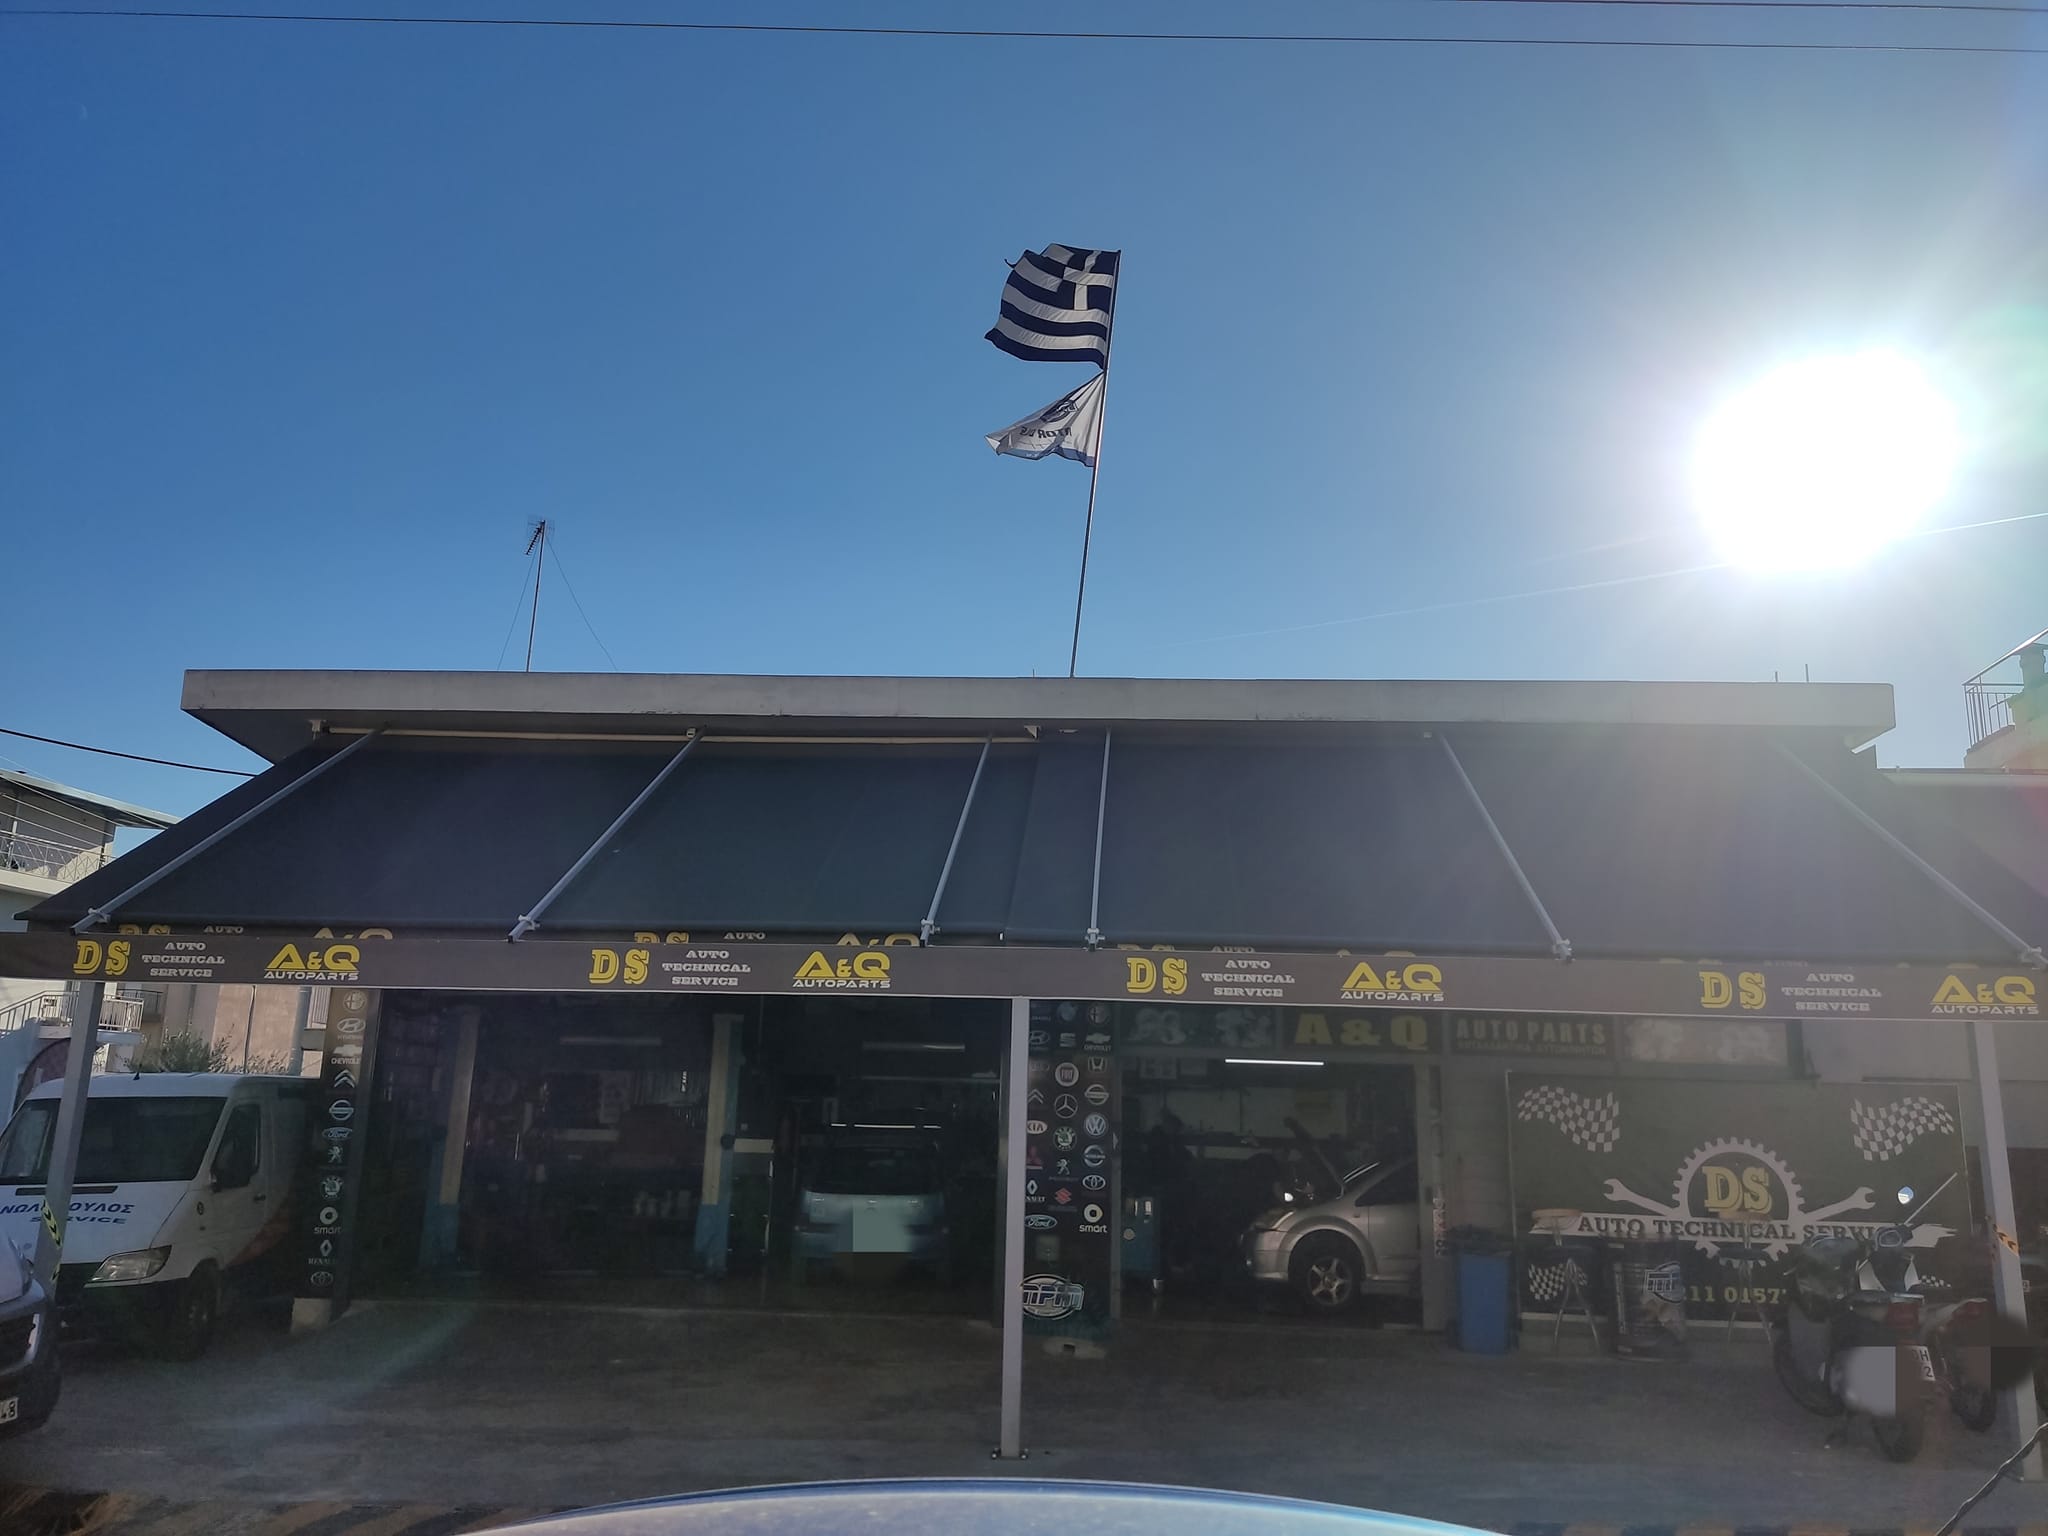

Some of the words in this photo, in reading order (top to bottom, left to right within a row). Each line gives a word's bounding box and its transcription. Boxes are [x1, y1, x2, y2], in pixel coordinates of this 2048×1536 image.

[204, 925, 243, 934] AUTO
[724, 932, 766, 940] AUTO
[165, 942, 206, 951] AUTO
[73, 940, 130, 976] DS
[141, 955, 225, 964] TECHNICAL
[266, 943, 360, 970] A&Q
[686, 950, 729, 959] AUTO
[589, 948, 649, 985] DS
[662, 963, 751, 973] TECHNICAL
[794, 951, 890, 978] A&Q
[1225, 959, 1271, 969] AUTO
[150, 968, 213, 977] SERVICE
[264, 971, 360, 981] AUTOPARTS
[1126, 957, 1188, 995] DS
[1342, 962, 1442, 990] A&Q
[671, 976, 738, 986] SERVICE
[1201, 973, 1295, 983] TECHNICAL
[1806, 973, 1854, 983] AUTO
[792, 979, 890, 989] AUTOPARTS
[1931, 975, 2036, 1003] A&Q
[1213, 987, 1283, 997] SERVICE
[1699, 971, 1766, 1009] DS
[1781, 987, 1882, 998] TECHNICAL
[1341, 992, 1444, 1002] AUTOPARTS
[1795, 1001, 1870, 1012] SERVICE
[1930, 1005, 2039, 1015] AUTOPARTS
[1295, 1013, 1332, 1044] A
[1341, 1019, 1381, 1046] &
[1390, 1015, 1428, 1051] Q
[1456, 1017, 1518, 1041] AUTO
[1528, 1021, 1606, 1045] PARTS
[1702, 1165, 1773, 1215] DS
[1079, 1225, 1108, 1233] smart
[1578, 1216, 1644, 1236] AUTO
[1653, 1219, 1795, 1239] TECHNICAL
